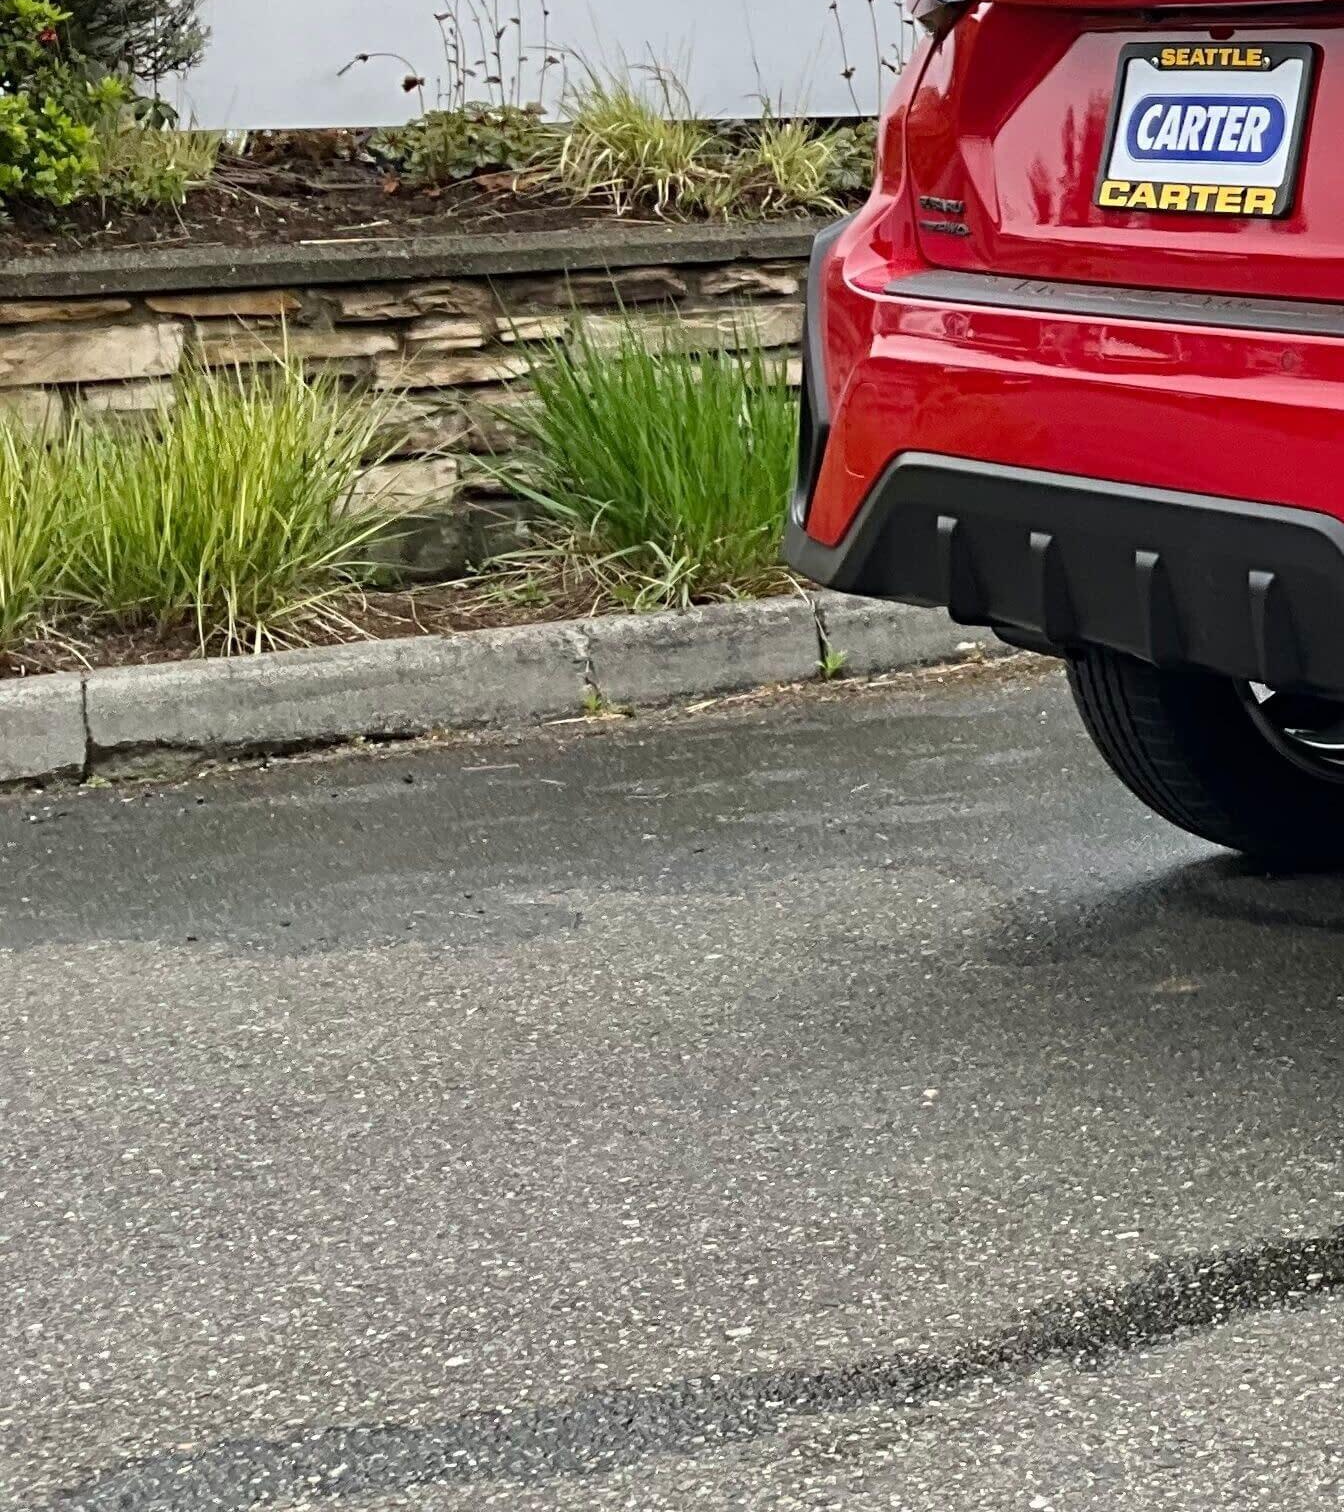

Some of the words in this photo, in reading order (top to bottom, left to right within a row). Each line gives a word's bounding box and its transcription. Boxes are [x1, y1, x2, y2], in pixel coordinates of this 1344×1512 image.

[1161, 48, 1263, 67] SEATTLE
[1136, 104, 1270, 153] CARTER
[1099, 180, 1276, 215] CARTER
